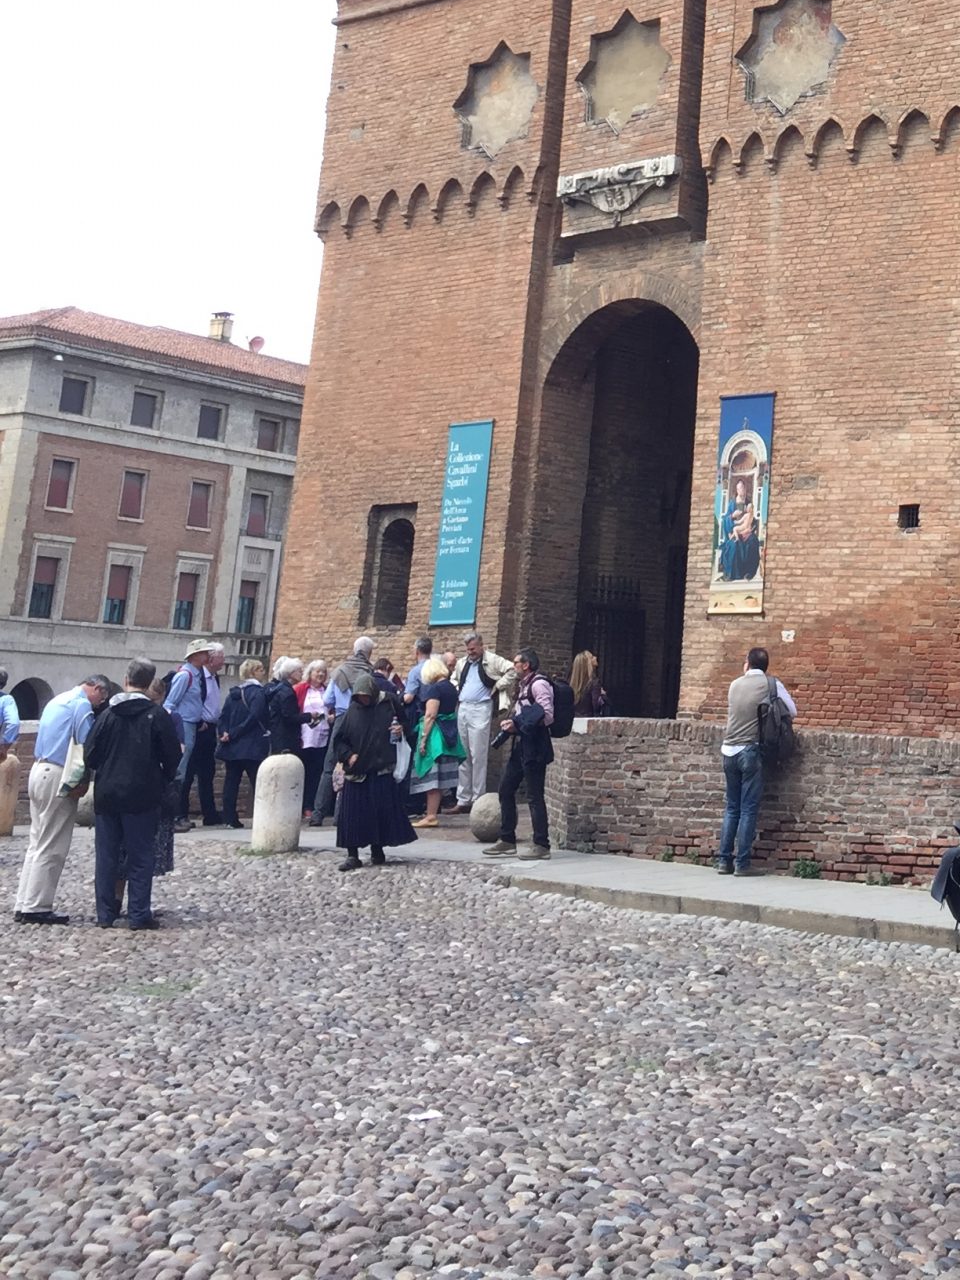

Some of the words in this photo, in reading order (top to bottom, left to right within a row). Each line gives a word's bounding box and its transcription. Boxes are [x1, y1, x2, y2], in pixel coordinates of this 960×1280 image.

[449, 452, 483, 463] Collezione
[448, 463, 478, 475] Cavallini
[447, 476, 469, 489] Sgarbi
